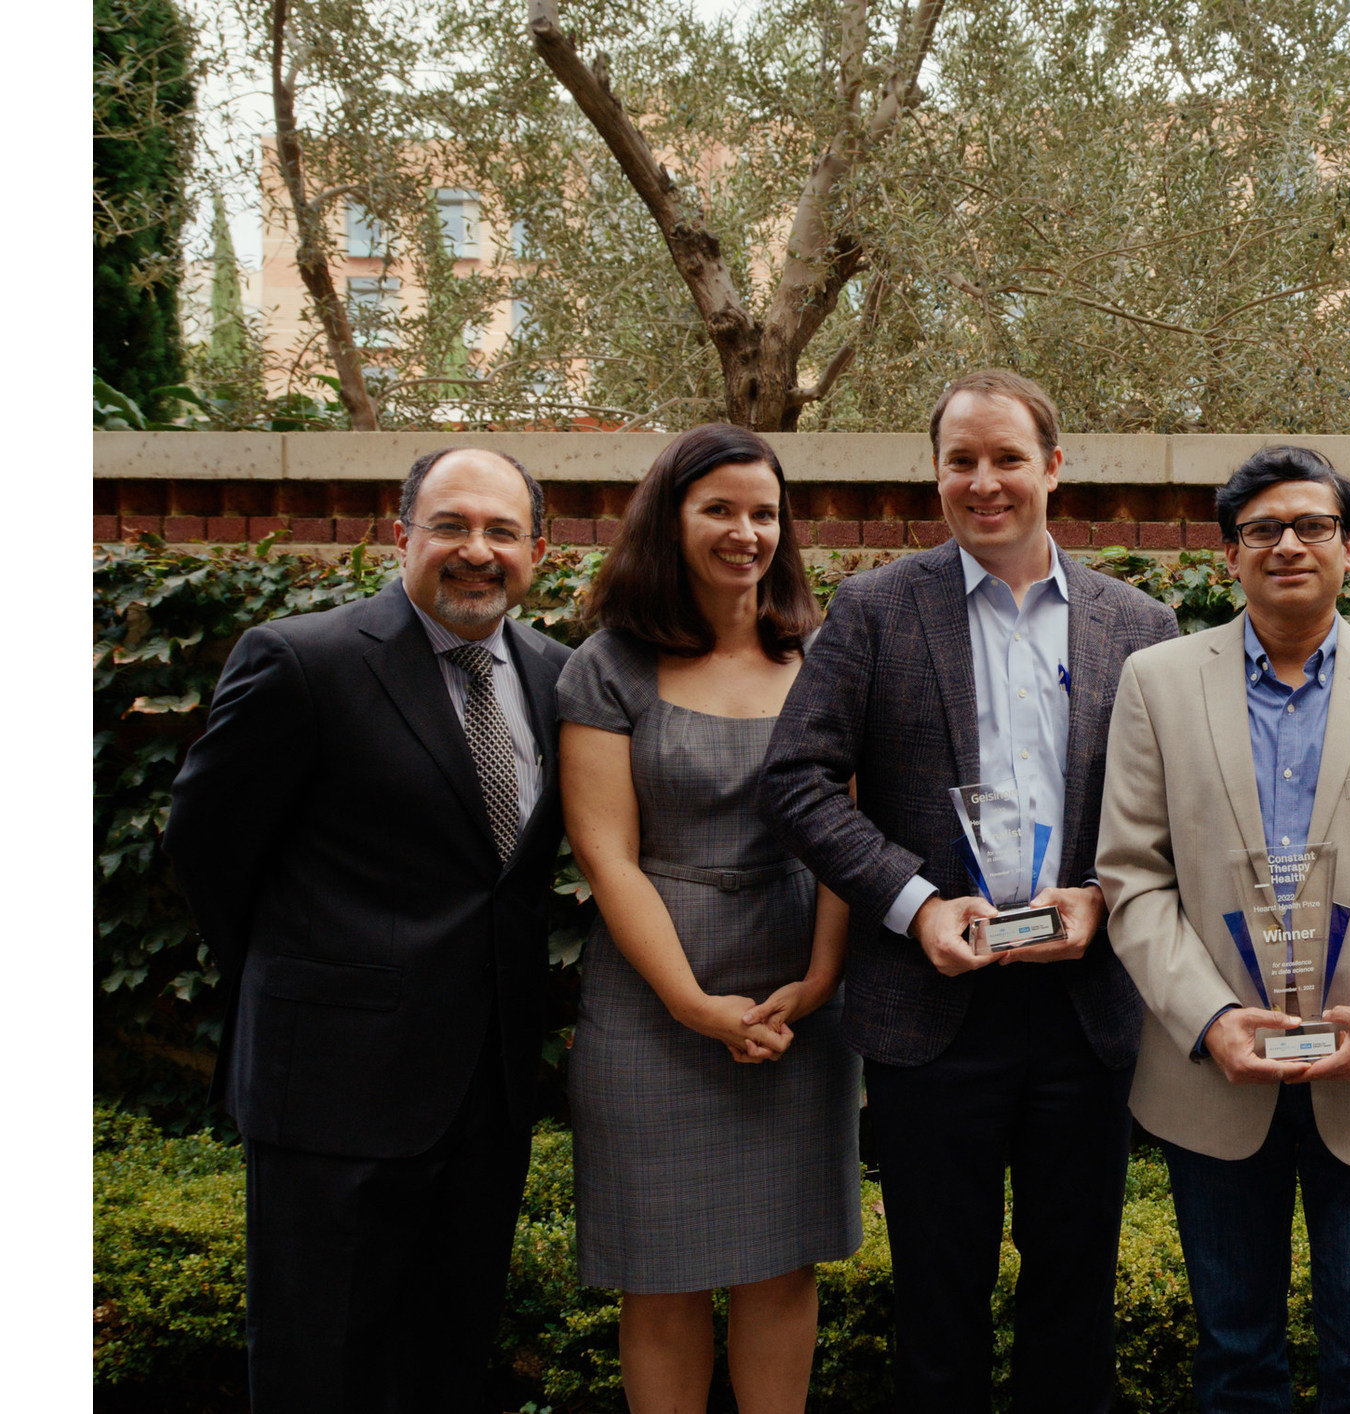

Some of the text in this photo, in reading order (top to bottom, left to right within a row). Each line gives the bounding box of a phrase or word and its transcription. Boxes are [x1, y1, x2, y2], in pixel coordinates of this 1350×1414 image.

[1268, 851, 1316, 863] Constant
[1268, 863, 1311, 873] Therapy
[1271, 873, 1306, 884] Health
[1277, 894, 1295, 902] 2022
[1253, 900, 1321, 913] Hearst Health Prize
[1263, 929, 1316, 943] Winner
[1292, 965, 1315, 974] science
